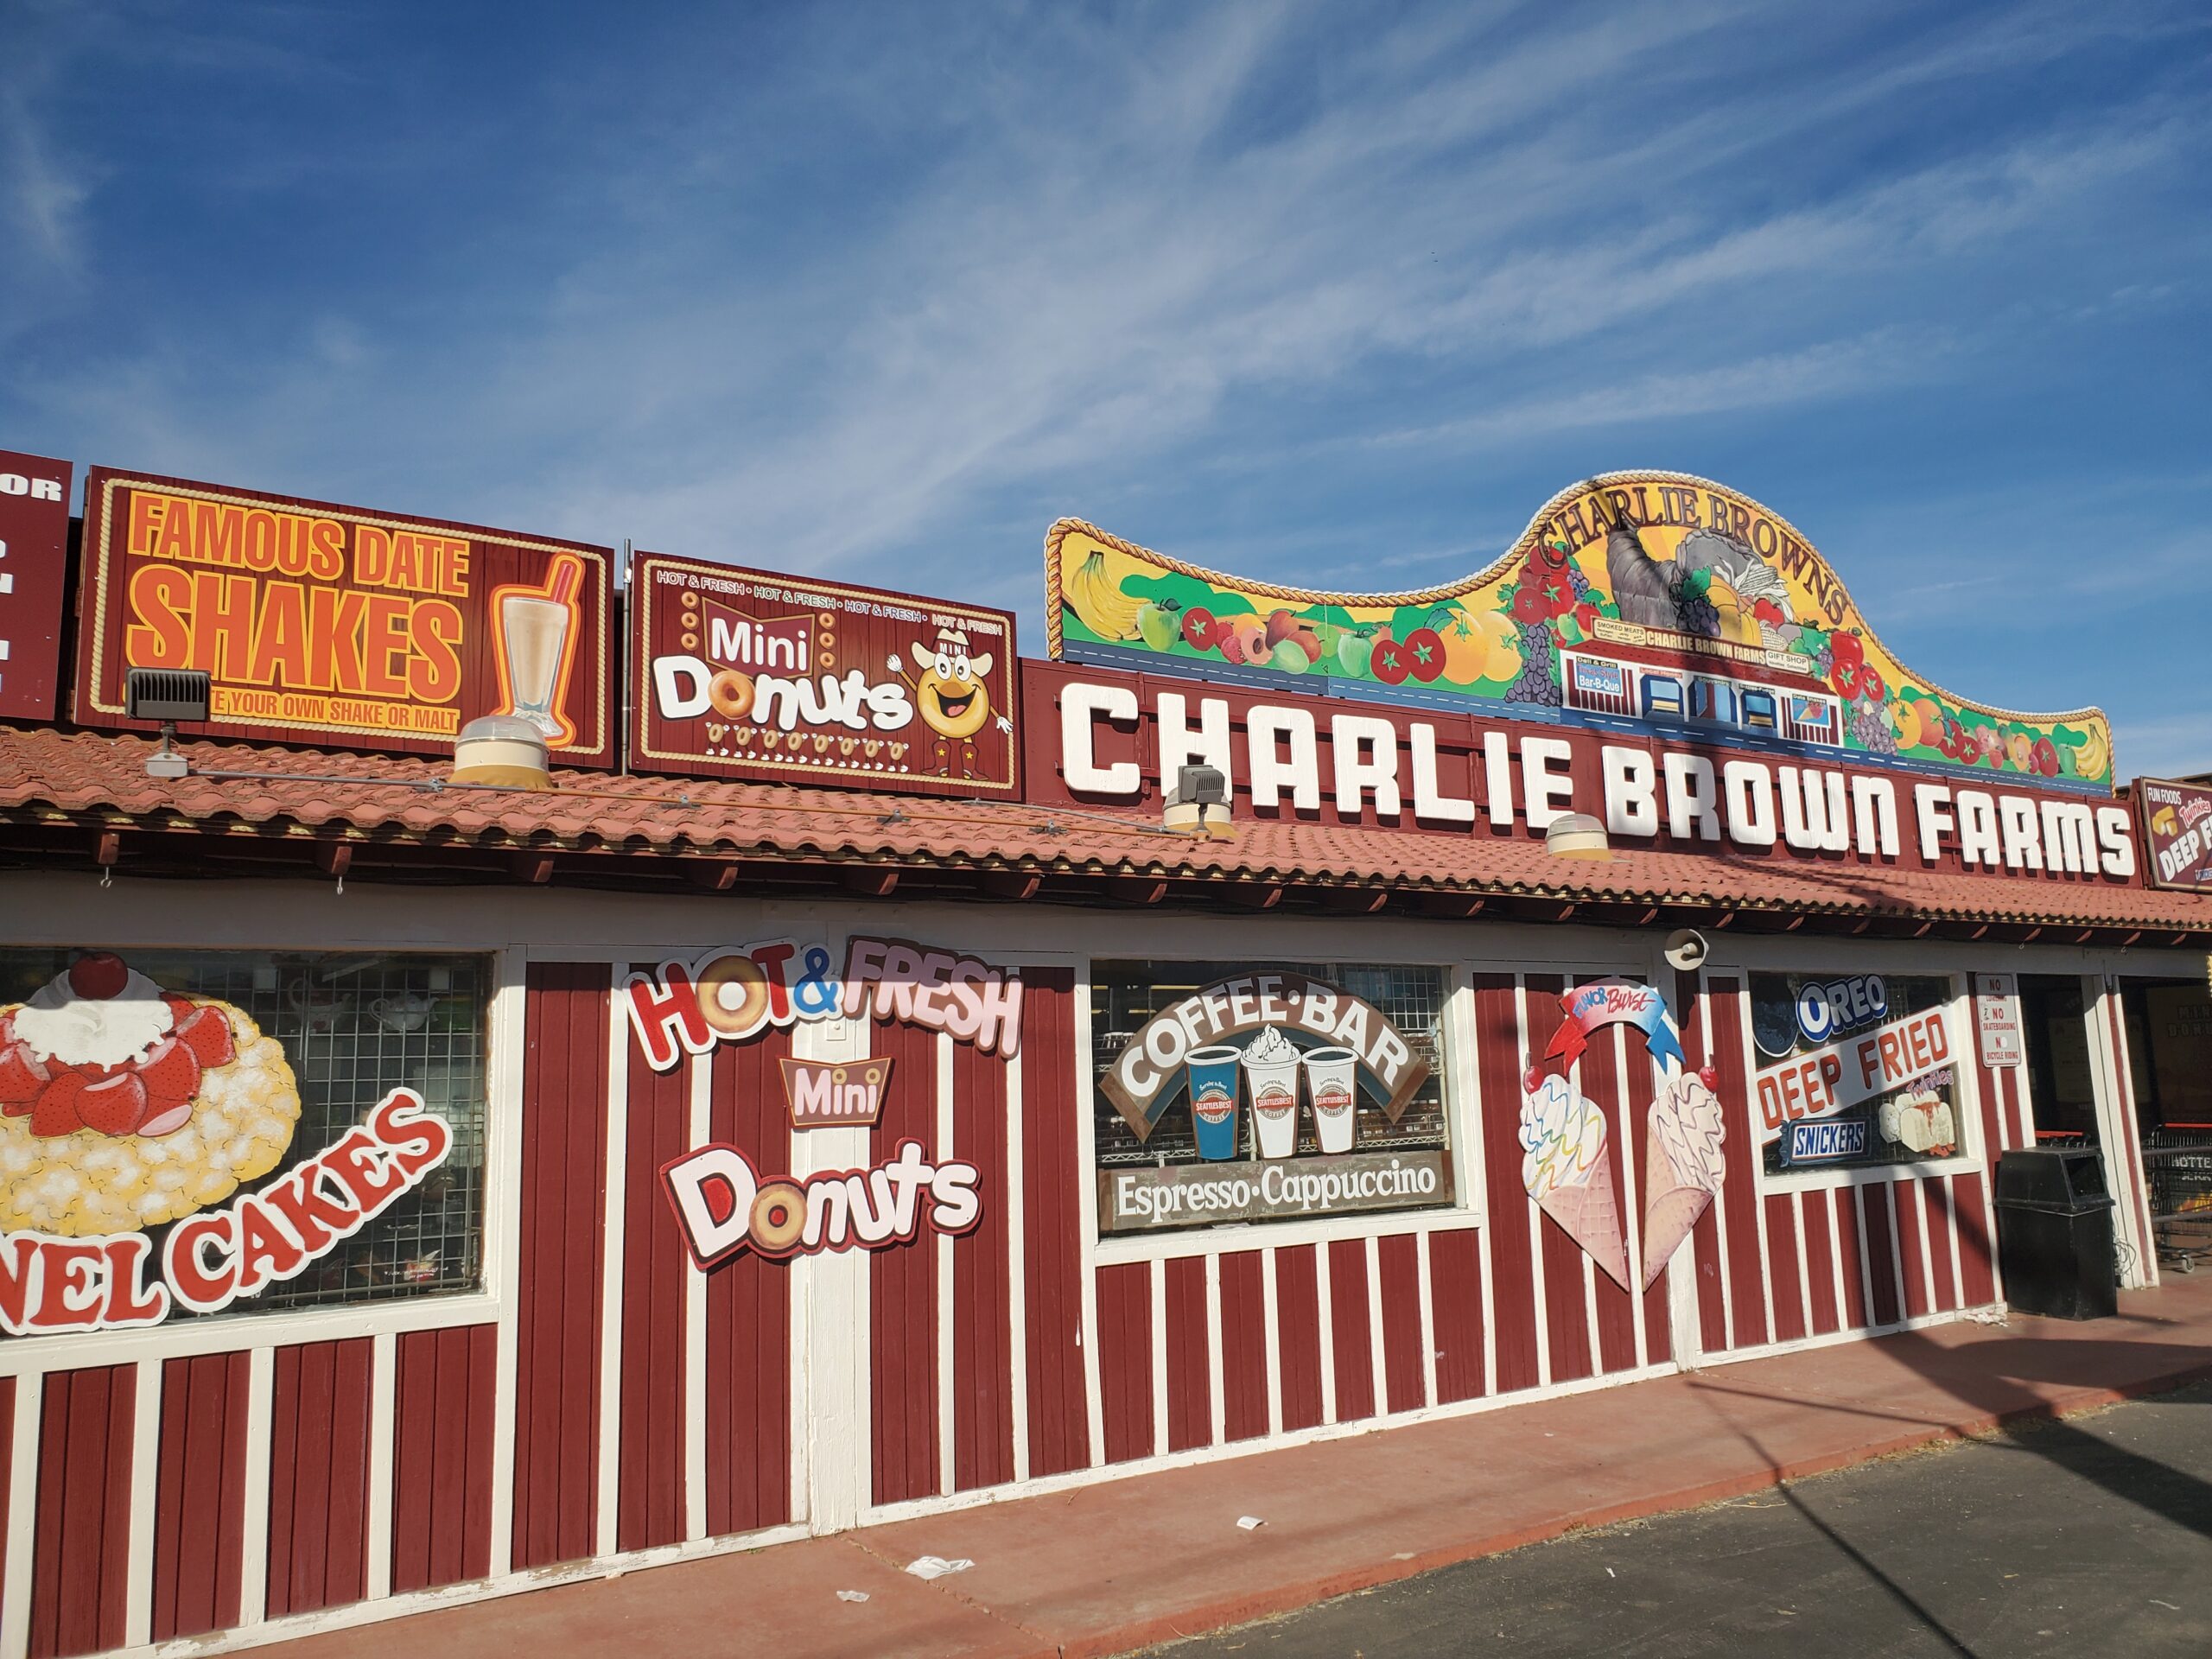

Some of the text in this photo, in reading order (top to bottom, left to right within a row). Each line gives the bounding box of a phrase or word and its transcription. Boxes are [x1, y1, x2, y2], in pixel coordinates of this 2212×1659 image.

[129, 491, 469, 597] FAMOUS DATE
[1538, 486, 1850, 625] CHARLIE BROWNS
[658, 571, 922, 623] HOT & FRESH HOT & FRESH HOT & FRESH
[126, 563, 463, 703] SHAKES
[932, 614, 1002, 636] HOT & FRESH
[1597, 621, 1623, 632] SMOKED
[1624, 626, 1643, 635] MEATS
[711, 617, 808, 671] Mini
[939, 642, 967, 655] MINI
[1646, 630, 1766, 665] CHARLIE BROWN FARMS
[1768, 652, 1806, 664] GIFT SHOP
[1580, 675, 1620, 691] Bar-B-Que
[1600, 668, 1618, 679] Style
[652, 654, 914, 731] Donuts
[229, 692, 278, 717] YOUR
[283, 697, 326, 721] OWN
[329, 701, 383, 727] SHAKE
[387, 706, 411, 728] OR
[415, 709, 459, 734] MALT
[1062, 683, 2136, 876] CHARLIE BROWN FARMS
[2147, 786, 2182, 805] FUN FOODS
[2179, 796, 2211, 829] Twinkies
[2159, 830, 2199, 881] DEEP
[1989, 978, 2001, 991] NO
[627, 938, 1023, 1066] HOT & FRESH
[1573, 987, 1656, 1019] FLAVOR Burst
[1797, 974, 1887, 1039] OREO
[1992, 1007, 2004, 1020] NO
[1122, 976, 1410, 1097] COFFEE BAR
[1983, 1022, 2016, 1031] SKATEBOARDING
[1995, 1036, 2007, 1049] N
[1757, 1013, 1949, 1131] DEEP FRIED
[1986, 1051, 2018, 1060] BICYCLE RIDING
[793, 1066, 881, 1116] Mini
[1280, 1096, 1292, 1105] BEST
[1338, 1095, 1349, 1104] BEST
[1906, 1070, 1955, 1102] Twinkies
[1218, 1100, 1232, 1109] BEST
[1794, 1123, 1865, 1156] SNICKERS
[172, 1092, 448, 1304] CAKES
[668, 1141, 980, 1259] Donuts
[1117, 1159, 1437, 1224] Espresso Cappuccino
